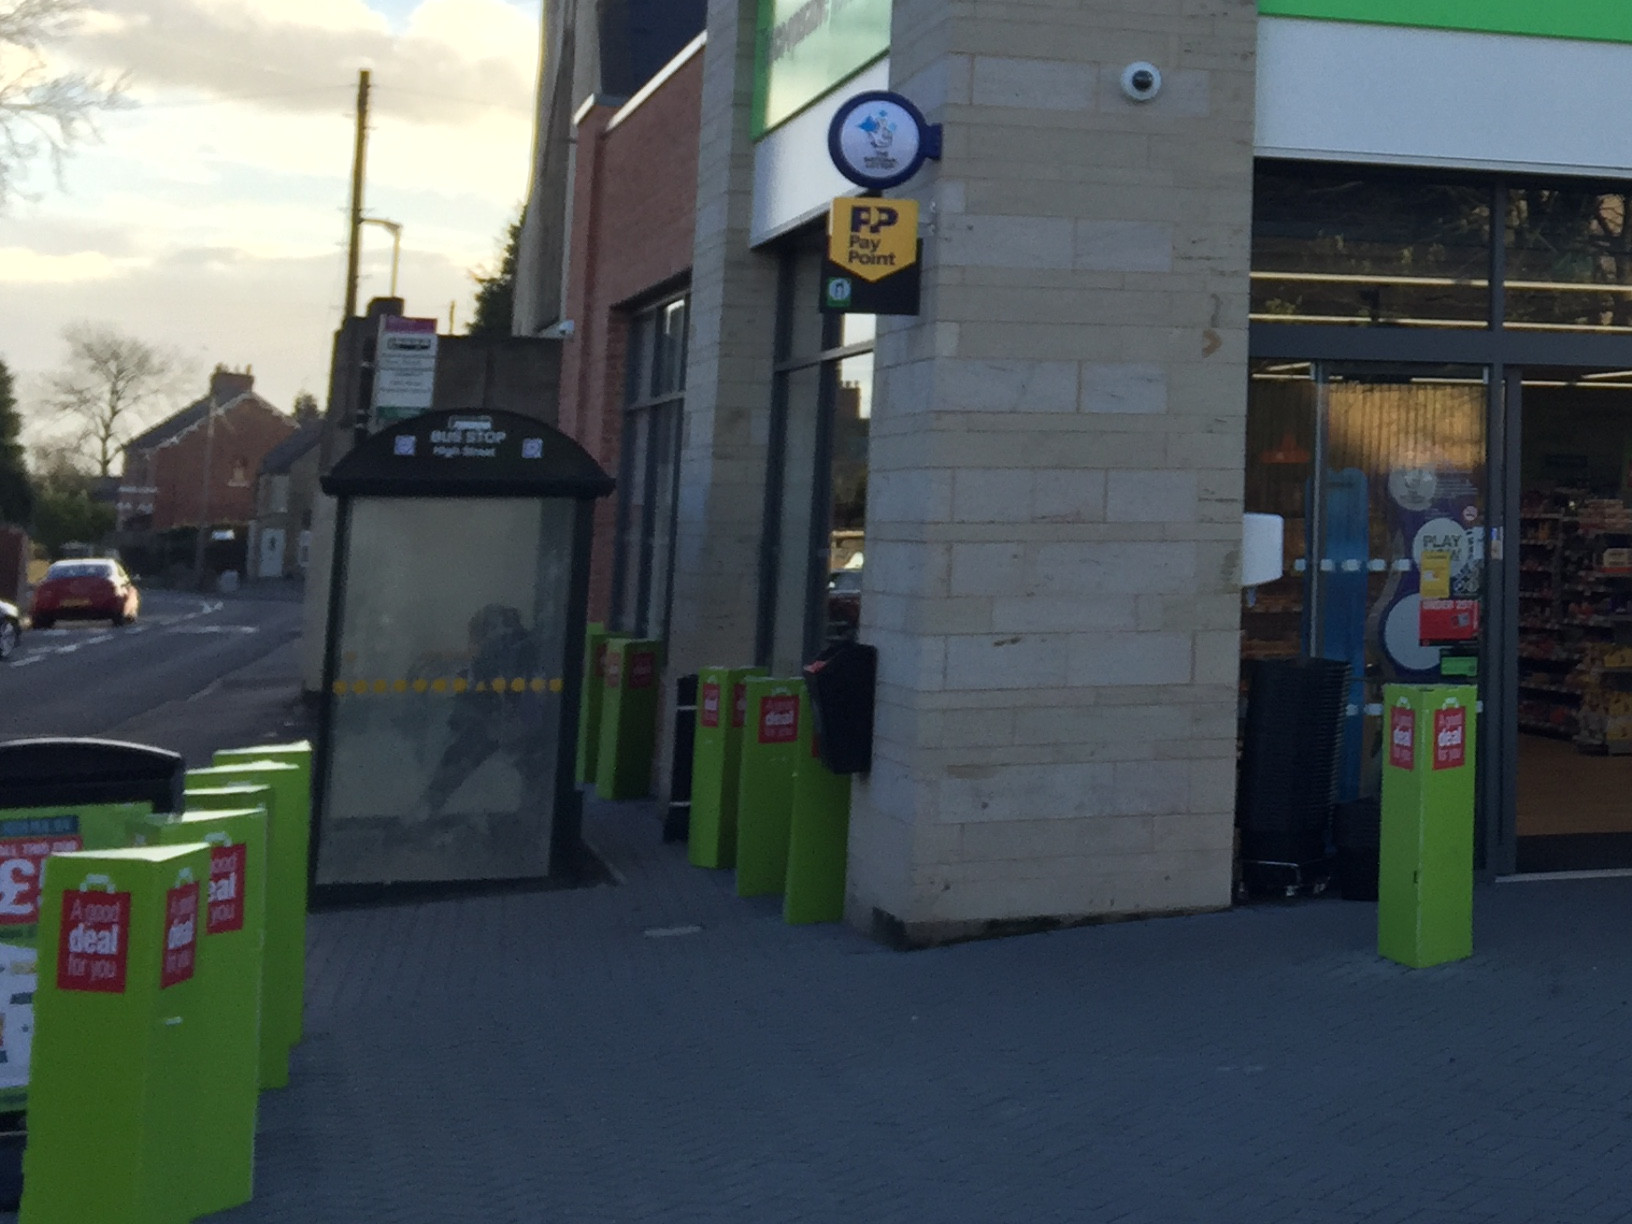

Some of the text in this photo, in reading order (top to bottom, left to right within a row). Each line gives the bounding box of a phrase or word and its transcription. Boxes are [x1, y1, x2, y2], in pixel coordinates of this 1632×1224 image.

[849, 234, 882, 253] Pay
[847, 249, 897, 266] Point
[465, 430, 508, 444] STOP
[1422, 534, 1462, 549] PLAY
[1437, 725, 1462, 746] deal
[209, 852, 238, 874] ood
[208, 871, 237, 903] eal
[69, 896, 120, 926] A good
[68, 921, 119, 956] deal
[67, 952, 118, 984] for you
